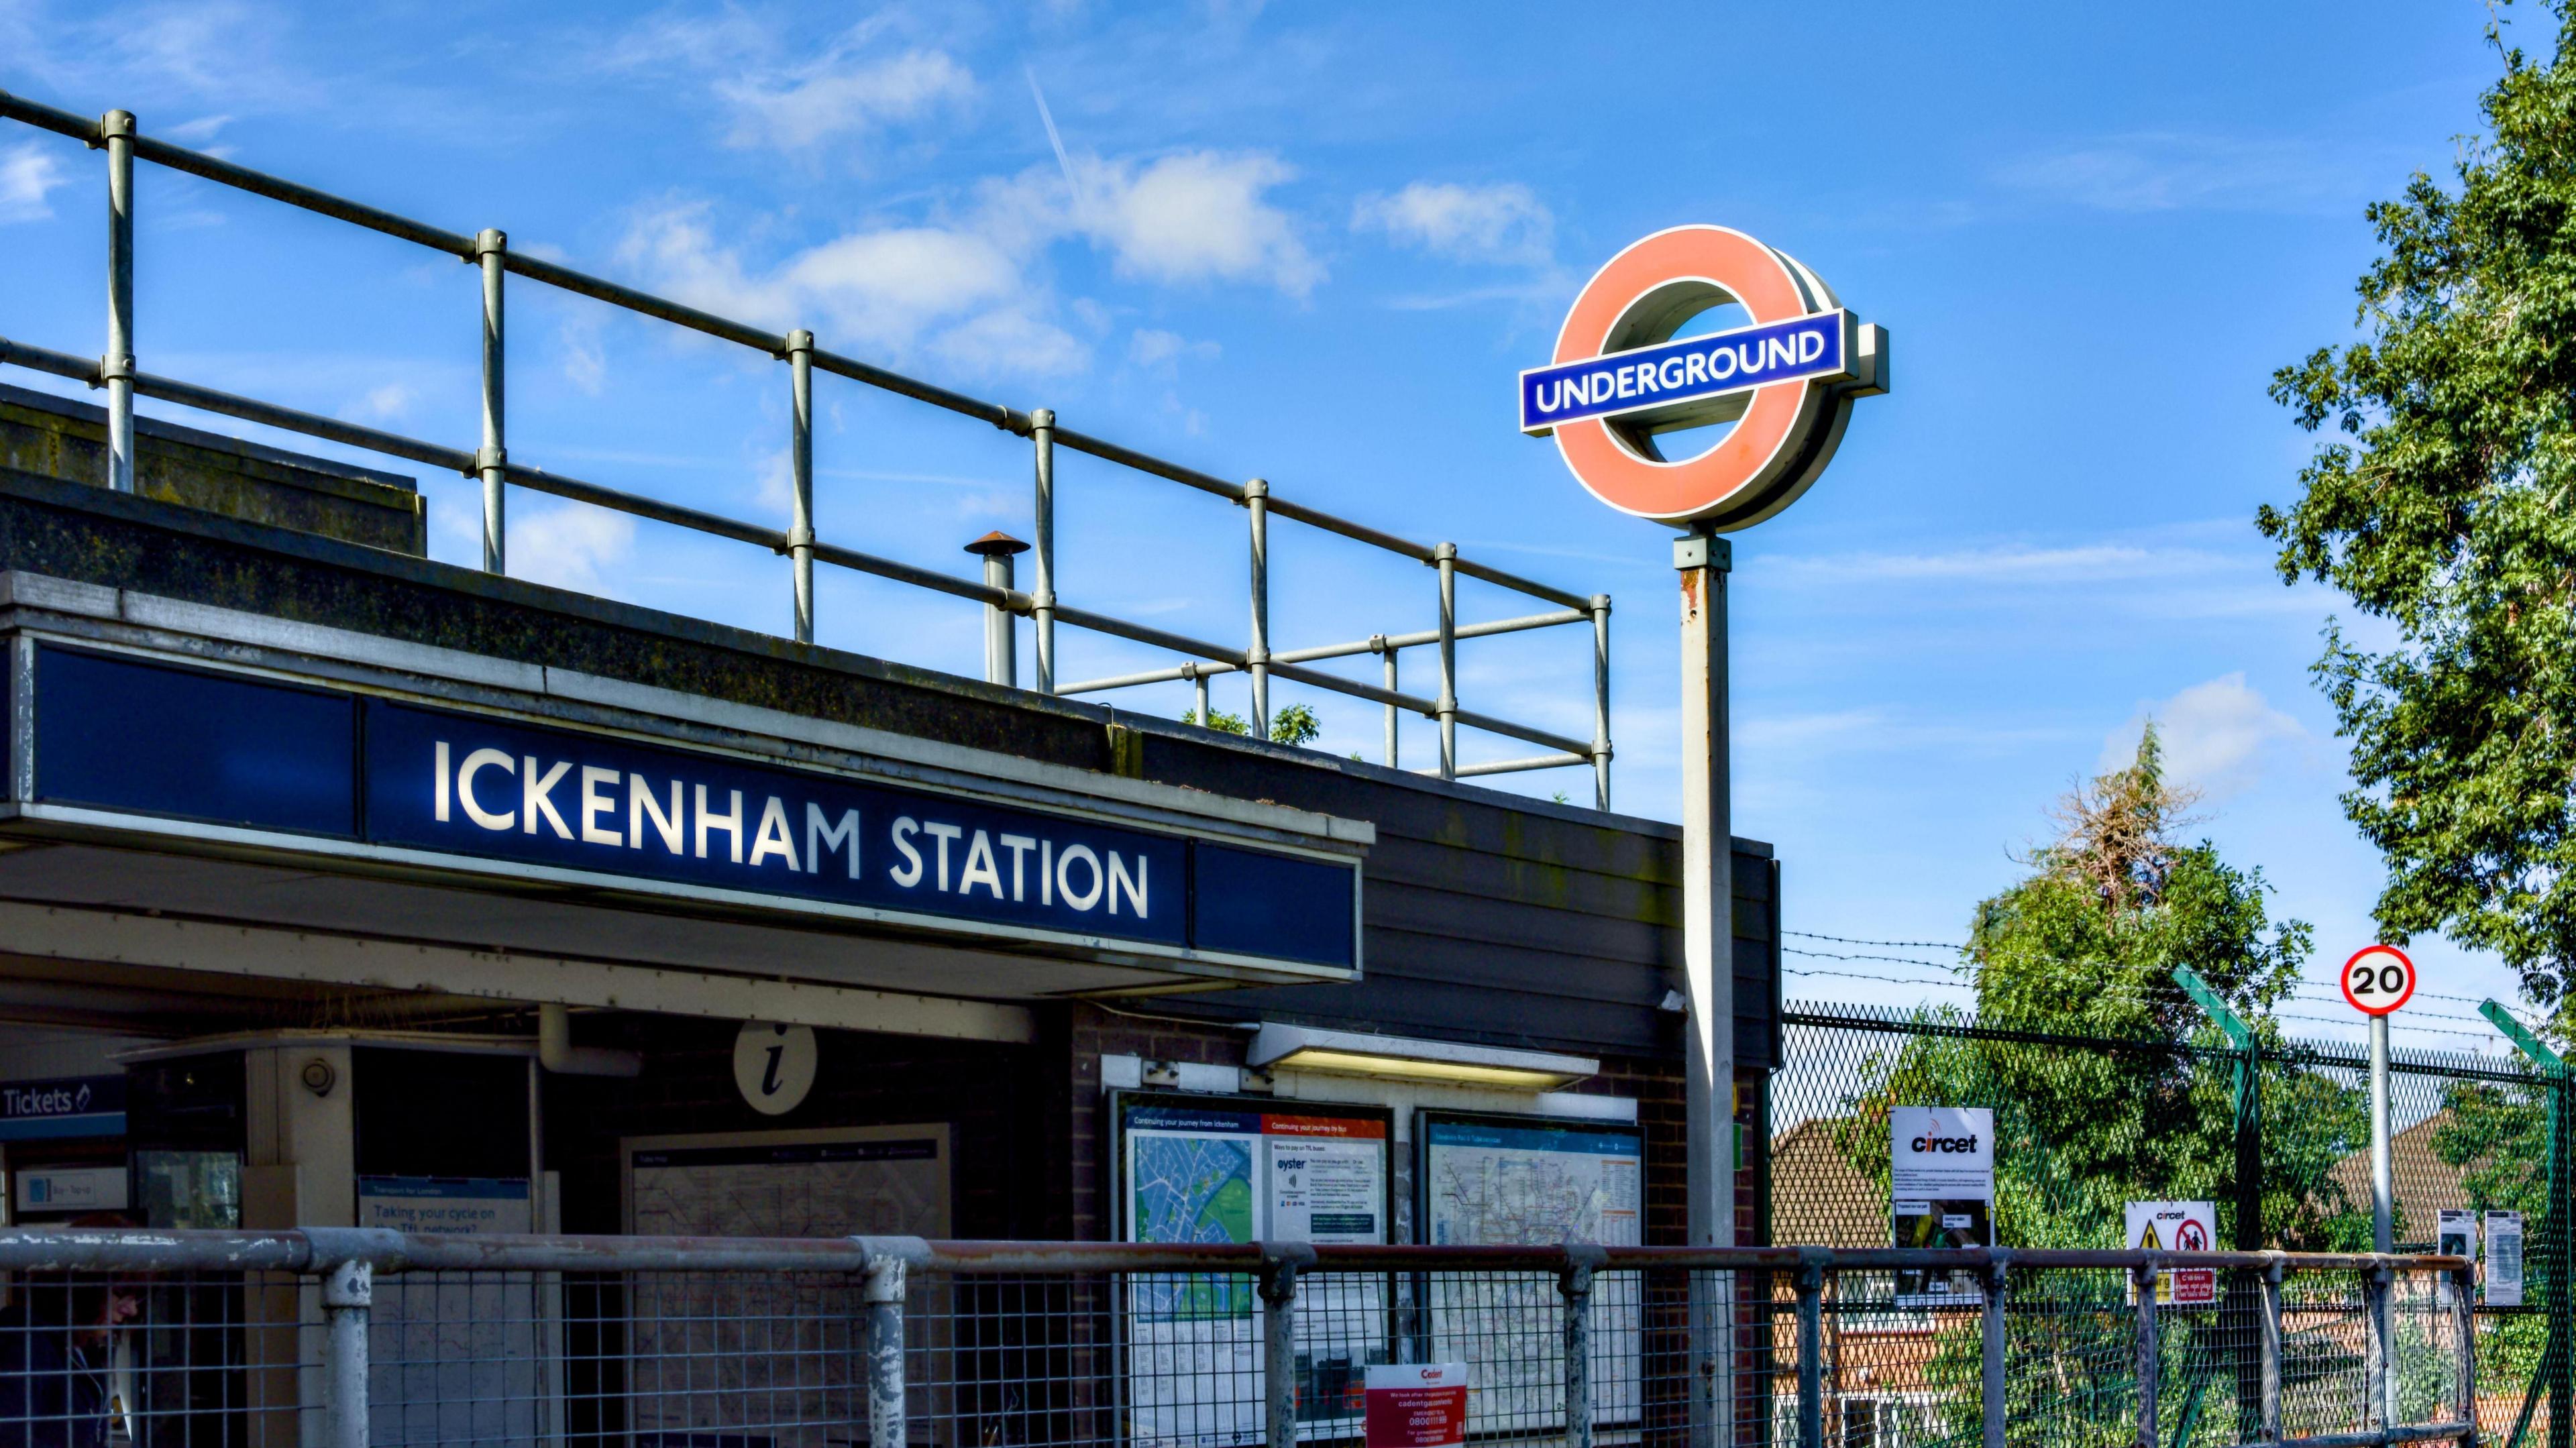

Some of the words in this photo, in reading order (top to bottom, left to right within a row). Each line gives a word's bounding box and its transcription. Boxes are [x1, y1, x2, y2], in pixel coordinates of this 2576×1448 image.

[1536, 330, 1825, 414] UNDERGROUND
[433, 740, 861, 881] ICKENHAM
[888, 815, 1148, 920] STATION
[2353, 965, 2404, 995] 20
[3, 1087, 72, 1115] Tickets
[1134, 1116, 1164, 1127] Continuing
[1165, 1119, 1177, 1127] your
[1178, 1119, 1199, 1128] journey
[1199, 1119, 1213, 1128] from
[1214, 1120, 1239, 1128] Ickenham
[1272, 1122, 1299, 1132] Continuing
[1300, 1125, 1311, 1133] your
[1311, 1125, 1331, 1133] journey
[1911, 1131, 1978, 1154] circet
[1277, 1158, 1305, 1172] oyster
[373, 1185, 405, 1194] Transport
[374, 1204, 415, 1221] Taking
[419, 1209, 445, 1221] your
[449, 1207, 478, 1221] cycle
[480, 1209, 495, 1219] on
[2156, 1210, 2186, 1220] circet
[1421, 1369, 1442, 1379] Cadent
[1409, 1417, 1430, 1426] 0800
